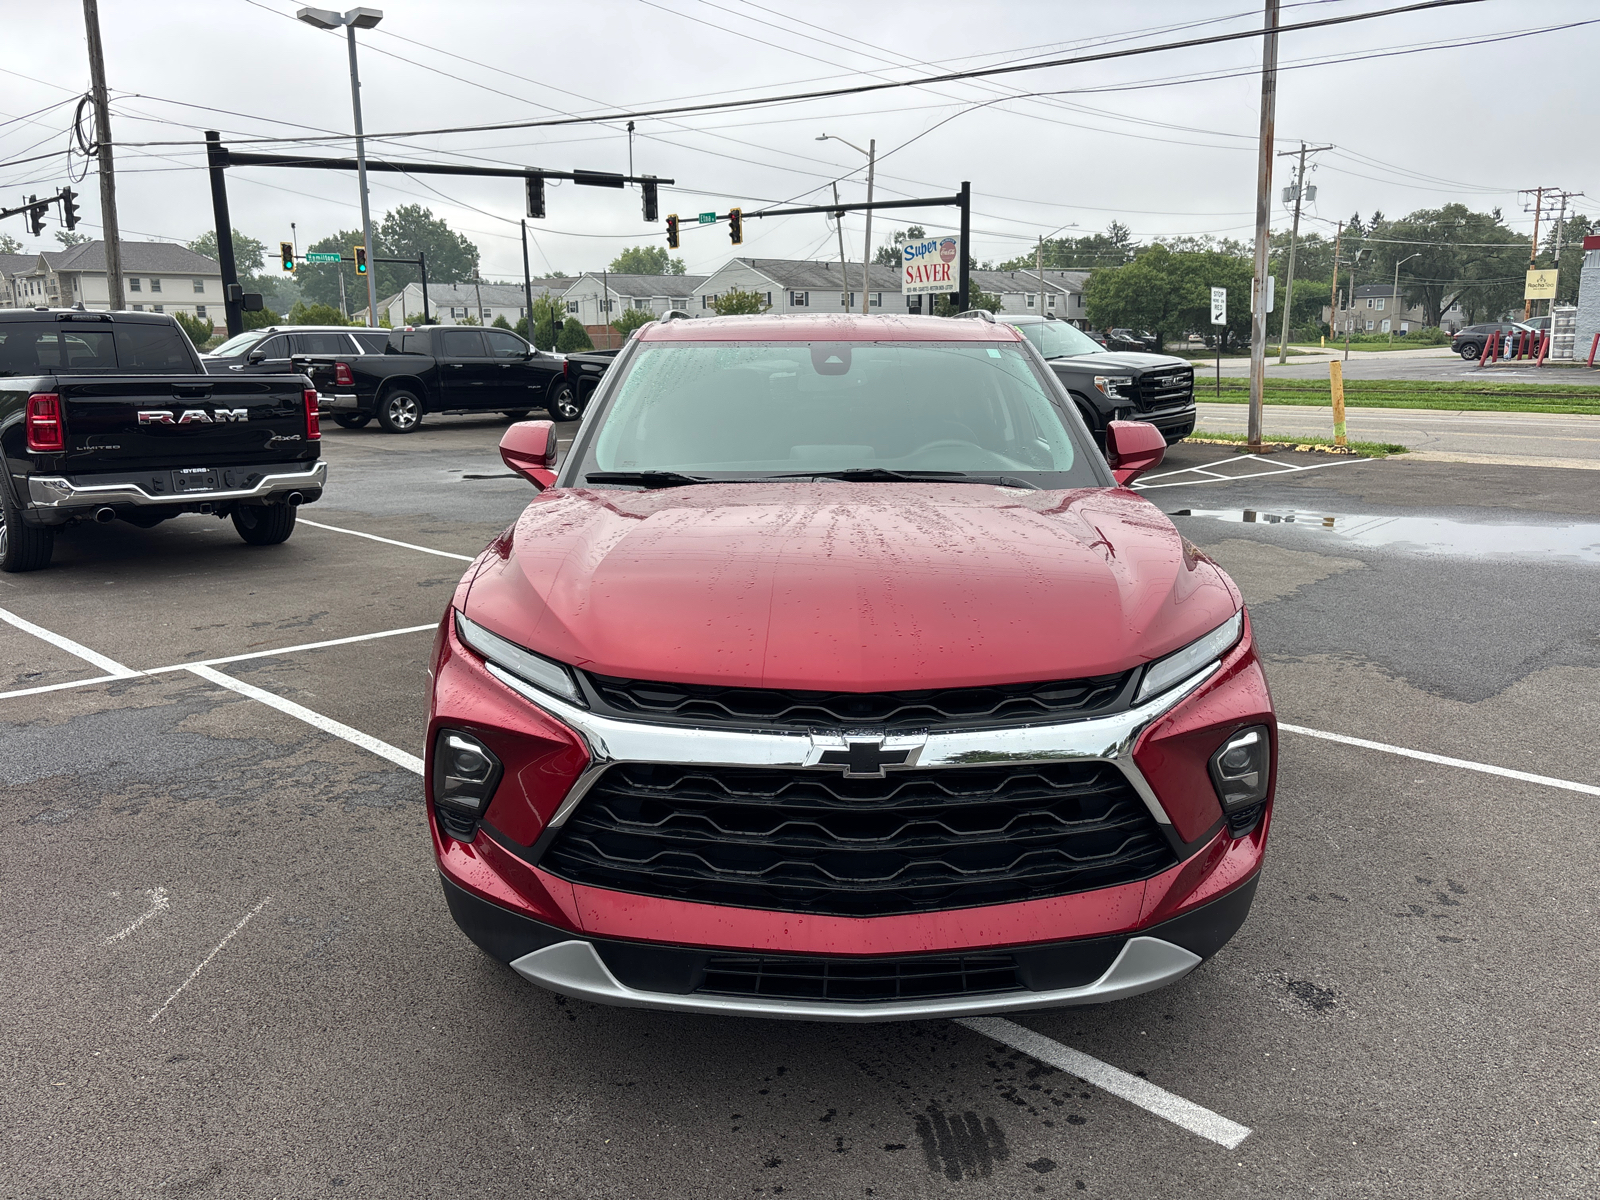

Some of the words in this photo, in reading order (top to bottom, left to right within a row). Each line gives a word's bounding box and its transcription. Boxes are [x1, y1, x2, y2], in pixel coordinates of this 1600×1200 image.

[904, 240, 937, 261] Super
[906, 263, 951, 284] SAVER
[1213, 290, 1224, 298] STOP
[138, 408, 249, 425] RAM
